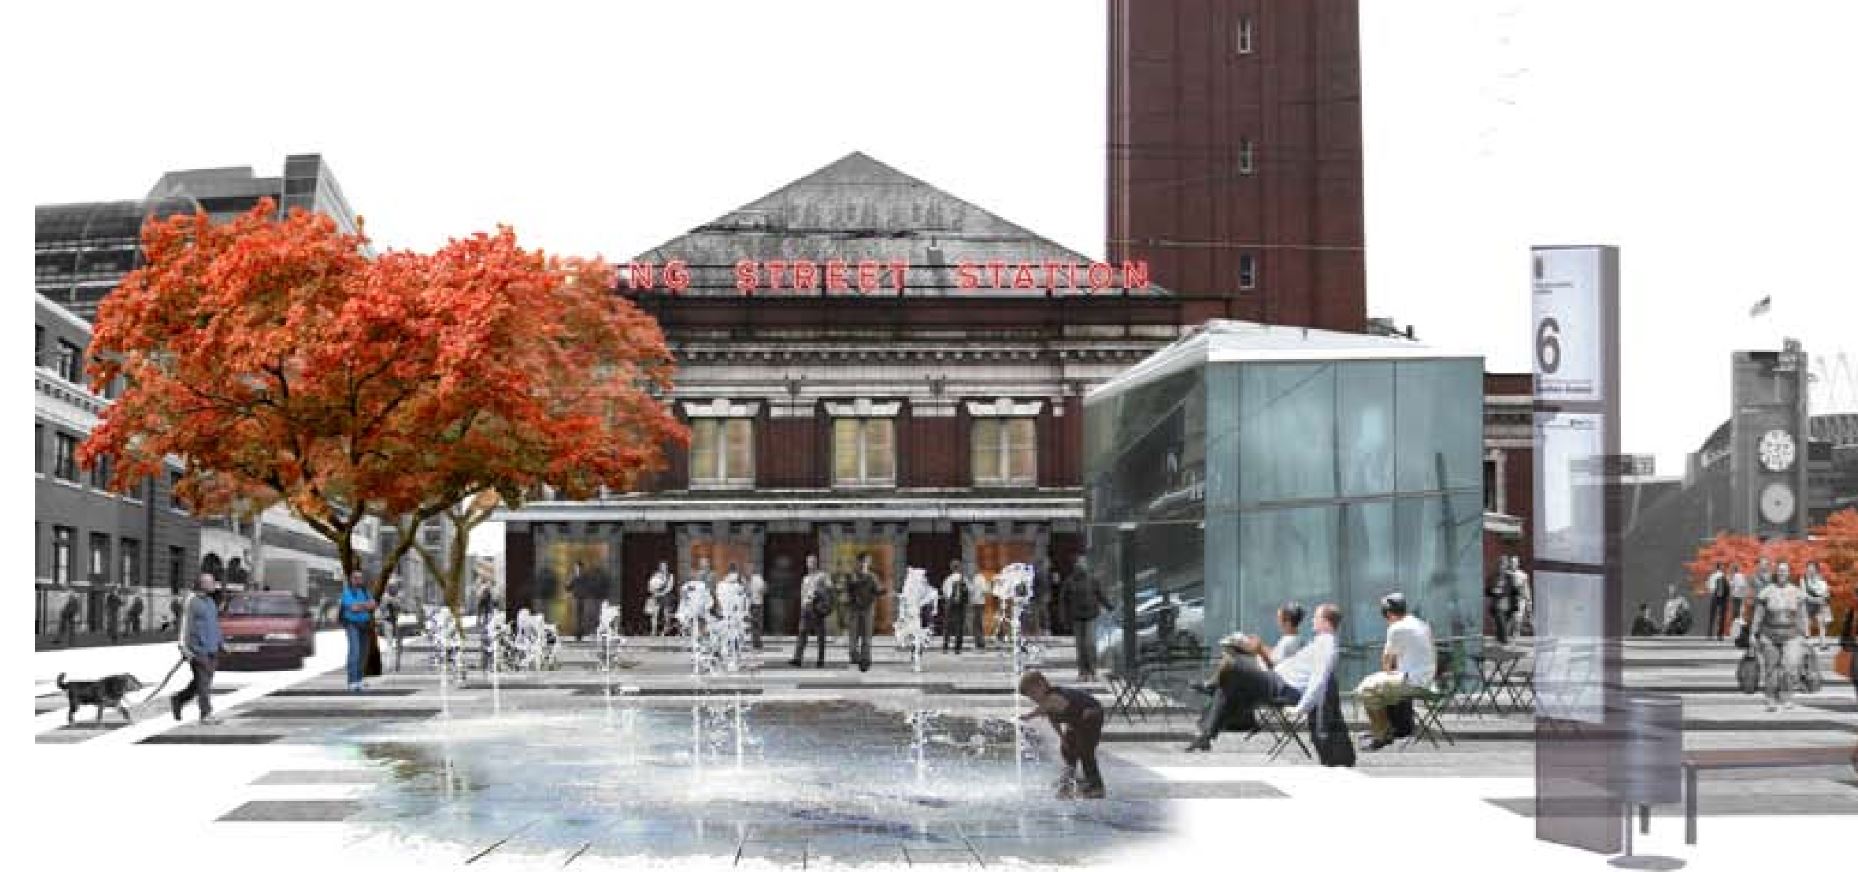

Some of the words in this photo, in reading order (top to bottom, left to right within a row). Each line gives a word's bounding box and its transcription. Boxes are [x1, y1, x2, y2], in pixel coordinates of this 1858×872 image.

[736, 260, 909, 290] STREET
[957, 260, 1149, 289] STATION
[1536, 317, 1561, 373] 6
